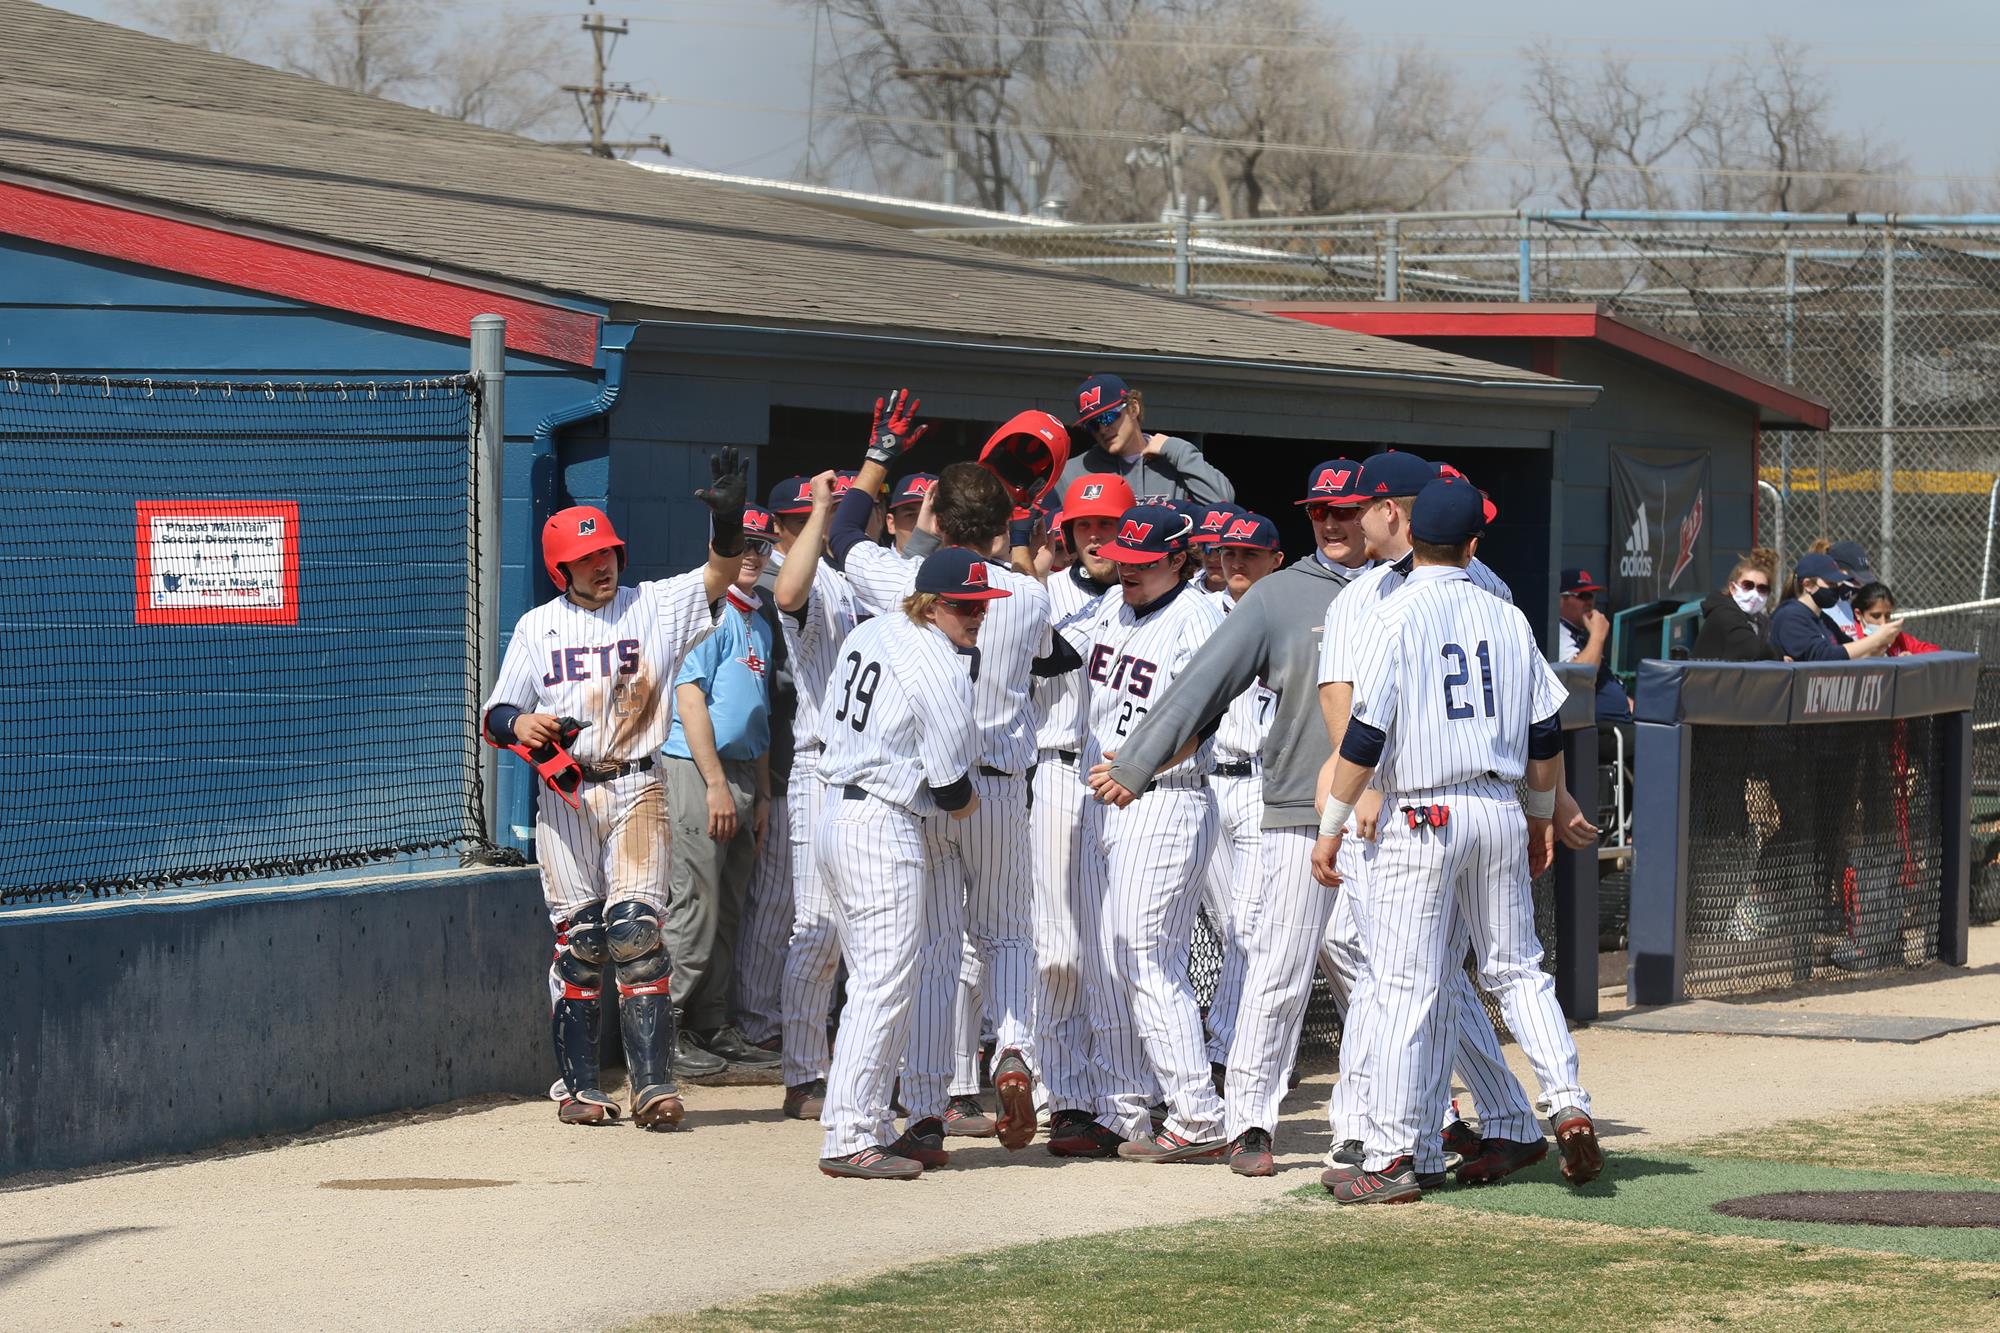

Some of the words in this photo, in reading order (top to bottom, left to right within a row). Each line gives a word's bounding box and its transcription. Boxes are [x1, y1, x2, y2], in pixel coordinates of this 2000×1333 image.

[1079, 386, 1101, 413] N
[1080, 484, 1104, 500] N
[1312, 469, 1352, 494] N
[166, 522, 208, 532] Please
[212, 522, 268, 532] Maintain
[577, 517, 596, 537] N
[1118, 519, 1154, 546] N
[1224, 519, 1260, 540] N
[161, 534, 200, 544] Social
[205, 534, 274, 547] Distancing
[1620, 551, 1653, 577] adidas
[188, 578, 216, 587] Wear
[230, 578, 258, 587] Mask
[262, 579, 274, 587] at
[201, 588, 222, 597] ALL
[227, 588, 261, 597] TIMES
[543, 639, 640, 688] JETS
[1089, 643, 1158, 699] ETS
[835, 650, 882, 733] 39
[1440, 640, 1496, 720] 21
[1803, 675, 1857, 714] NEWMAN
[1857, 674, 1884, 712] JETS
